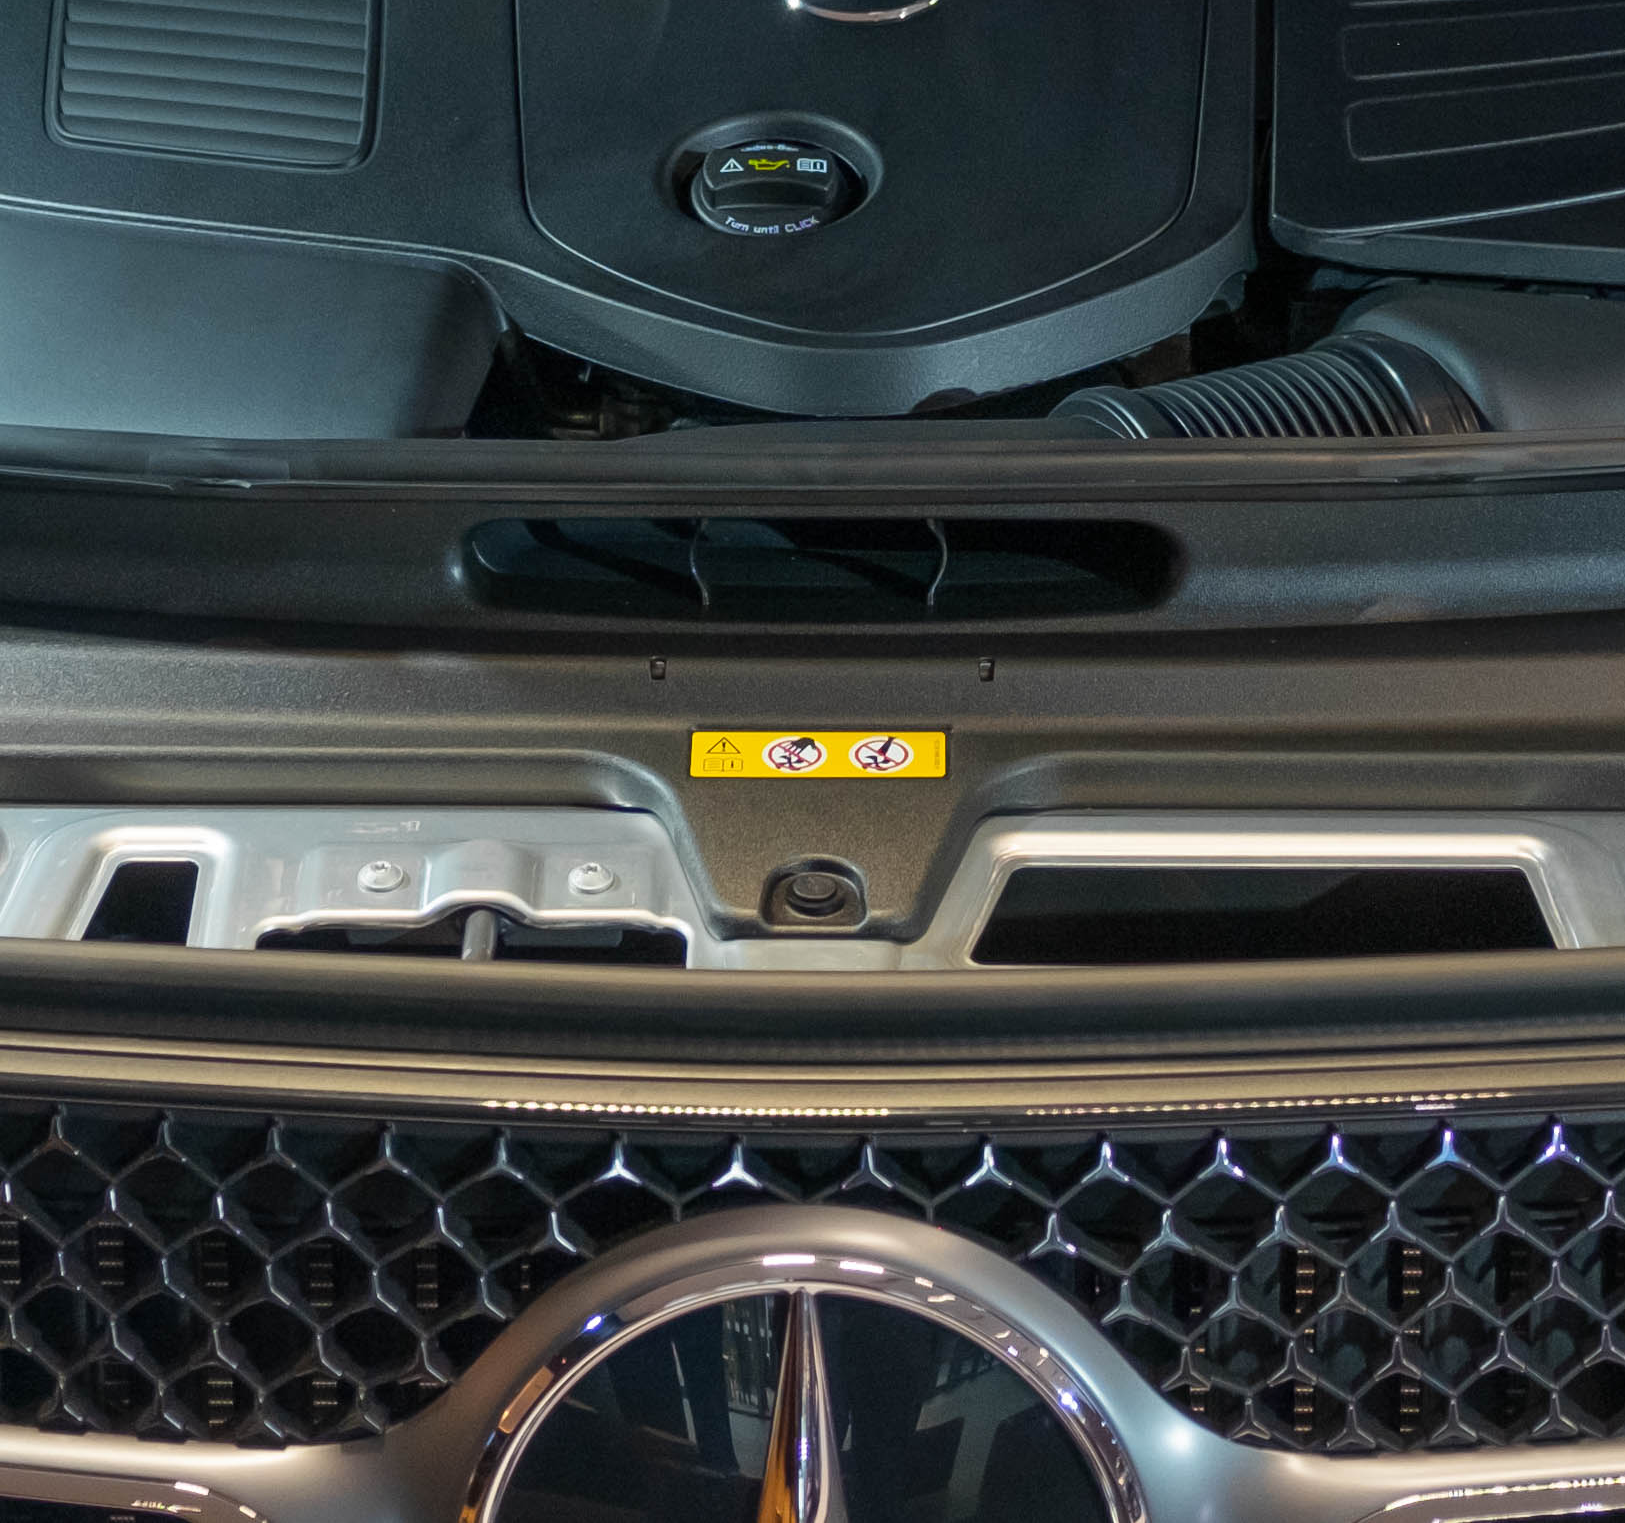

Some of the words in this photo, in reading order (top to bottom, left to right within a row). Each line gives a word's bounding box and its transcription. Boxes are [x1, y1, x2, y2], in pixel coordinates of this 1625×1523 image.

[725, 215, 749, 232] Turn
[753, 224, 779, 234] until
[784, 215, 820, 233] CLICK
